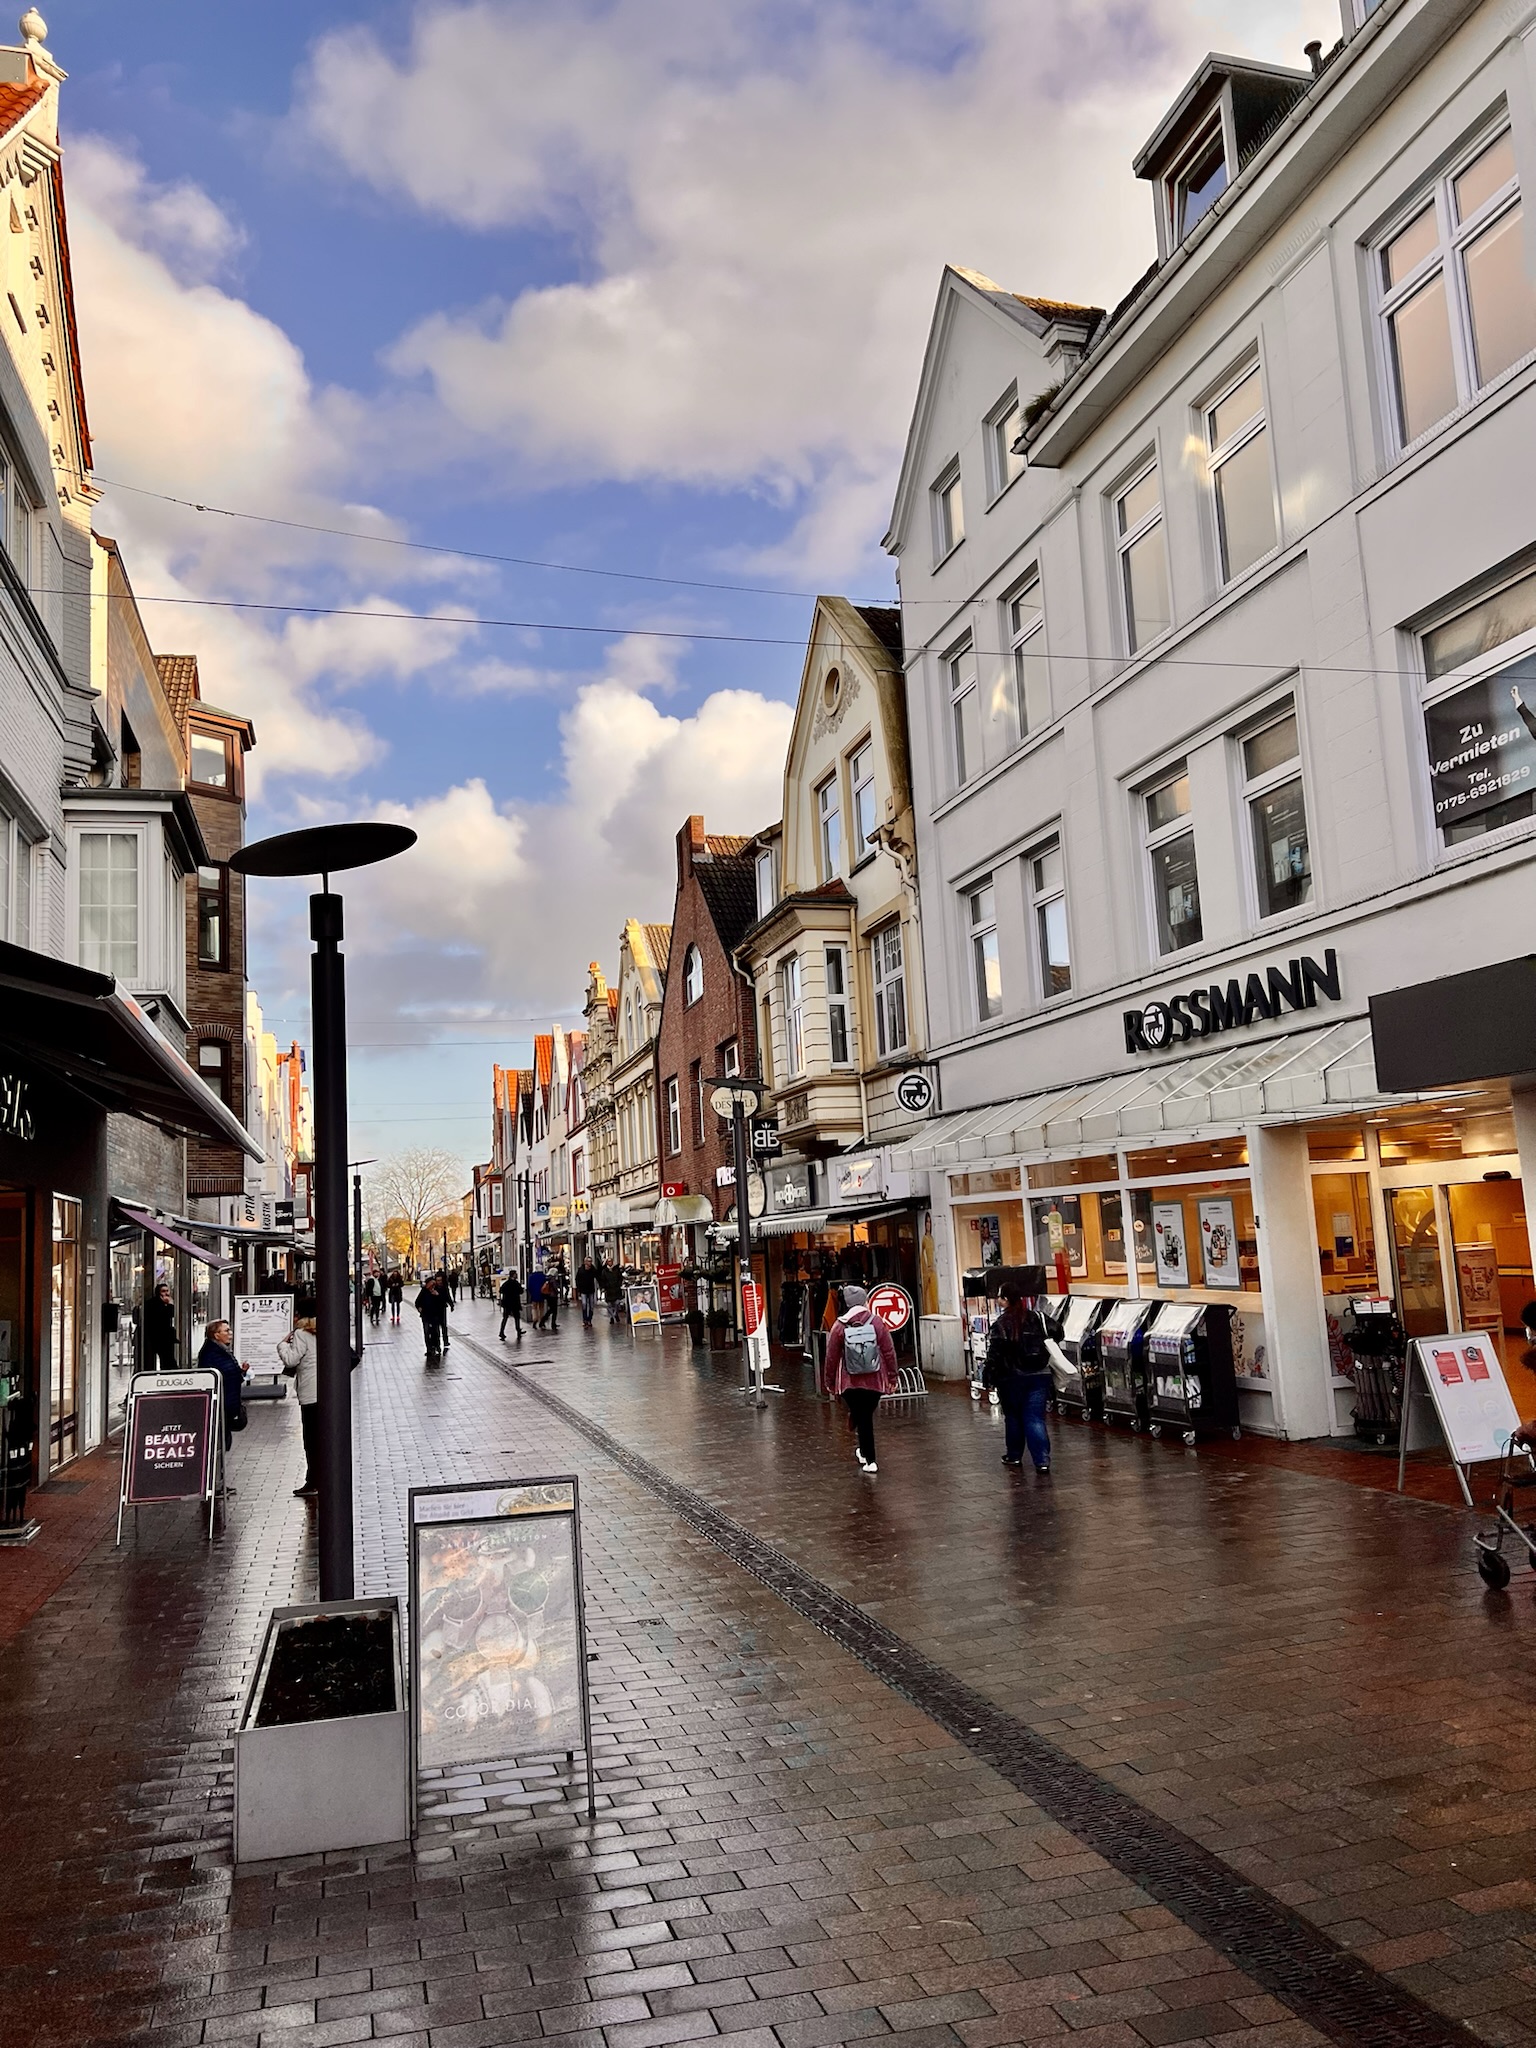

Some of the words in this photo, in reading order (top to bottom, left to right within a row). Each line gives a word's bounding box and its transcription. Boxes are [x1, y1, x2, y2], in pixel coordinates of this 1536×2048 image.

[1459, 723, 1483, 744] Zu
[1429, 727, 1520, 777] Vermieten
[1467, 768, 1491, 784] Tel.
[1436, 765, 1531, 813] 0175-6921829
[1123, 949, 1341, 1054] ROSSMANN
[245, 1195, 256, 1222] OPTIK
[156, 1378, 193, 1387] DOUGLAS
[161, 1424, 182, 1432] JETZT
[144, 1433, 197, 1446] BEAUTY
[144, 1446, 196, 1460] DEALS
